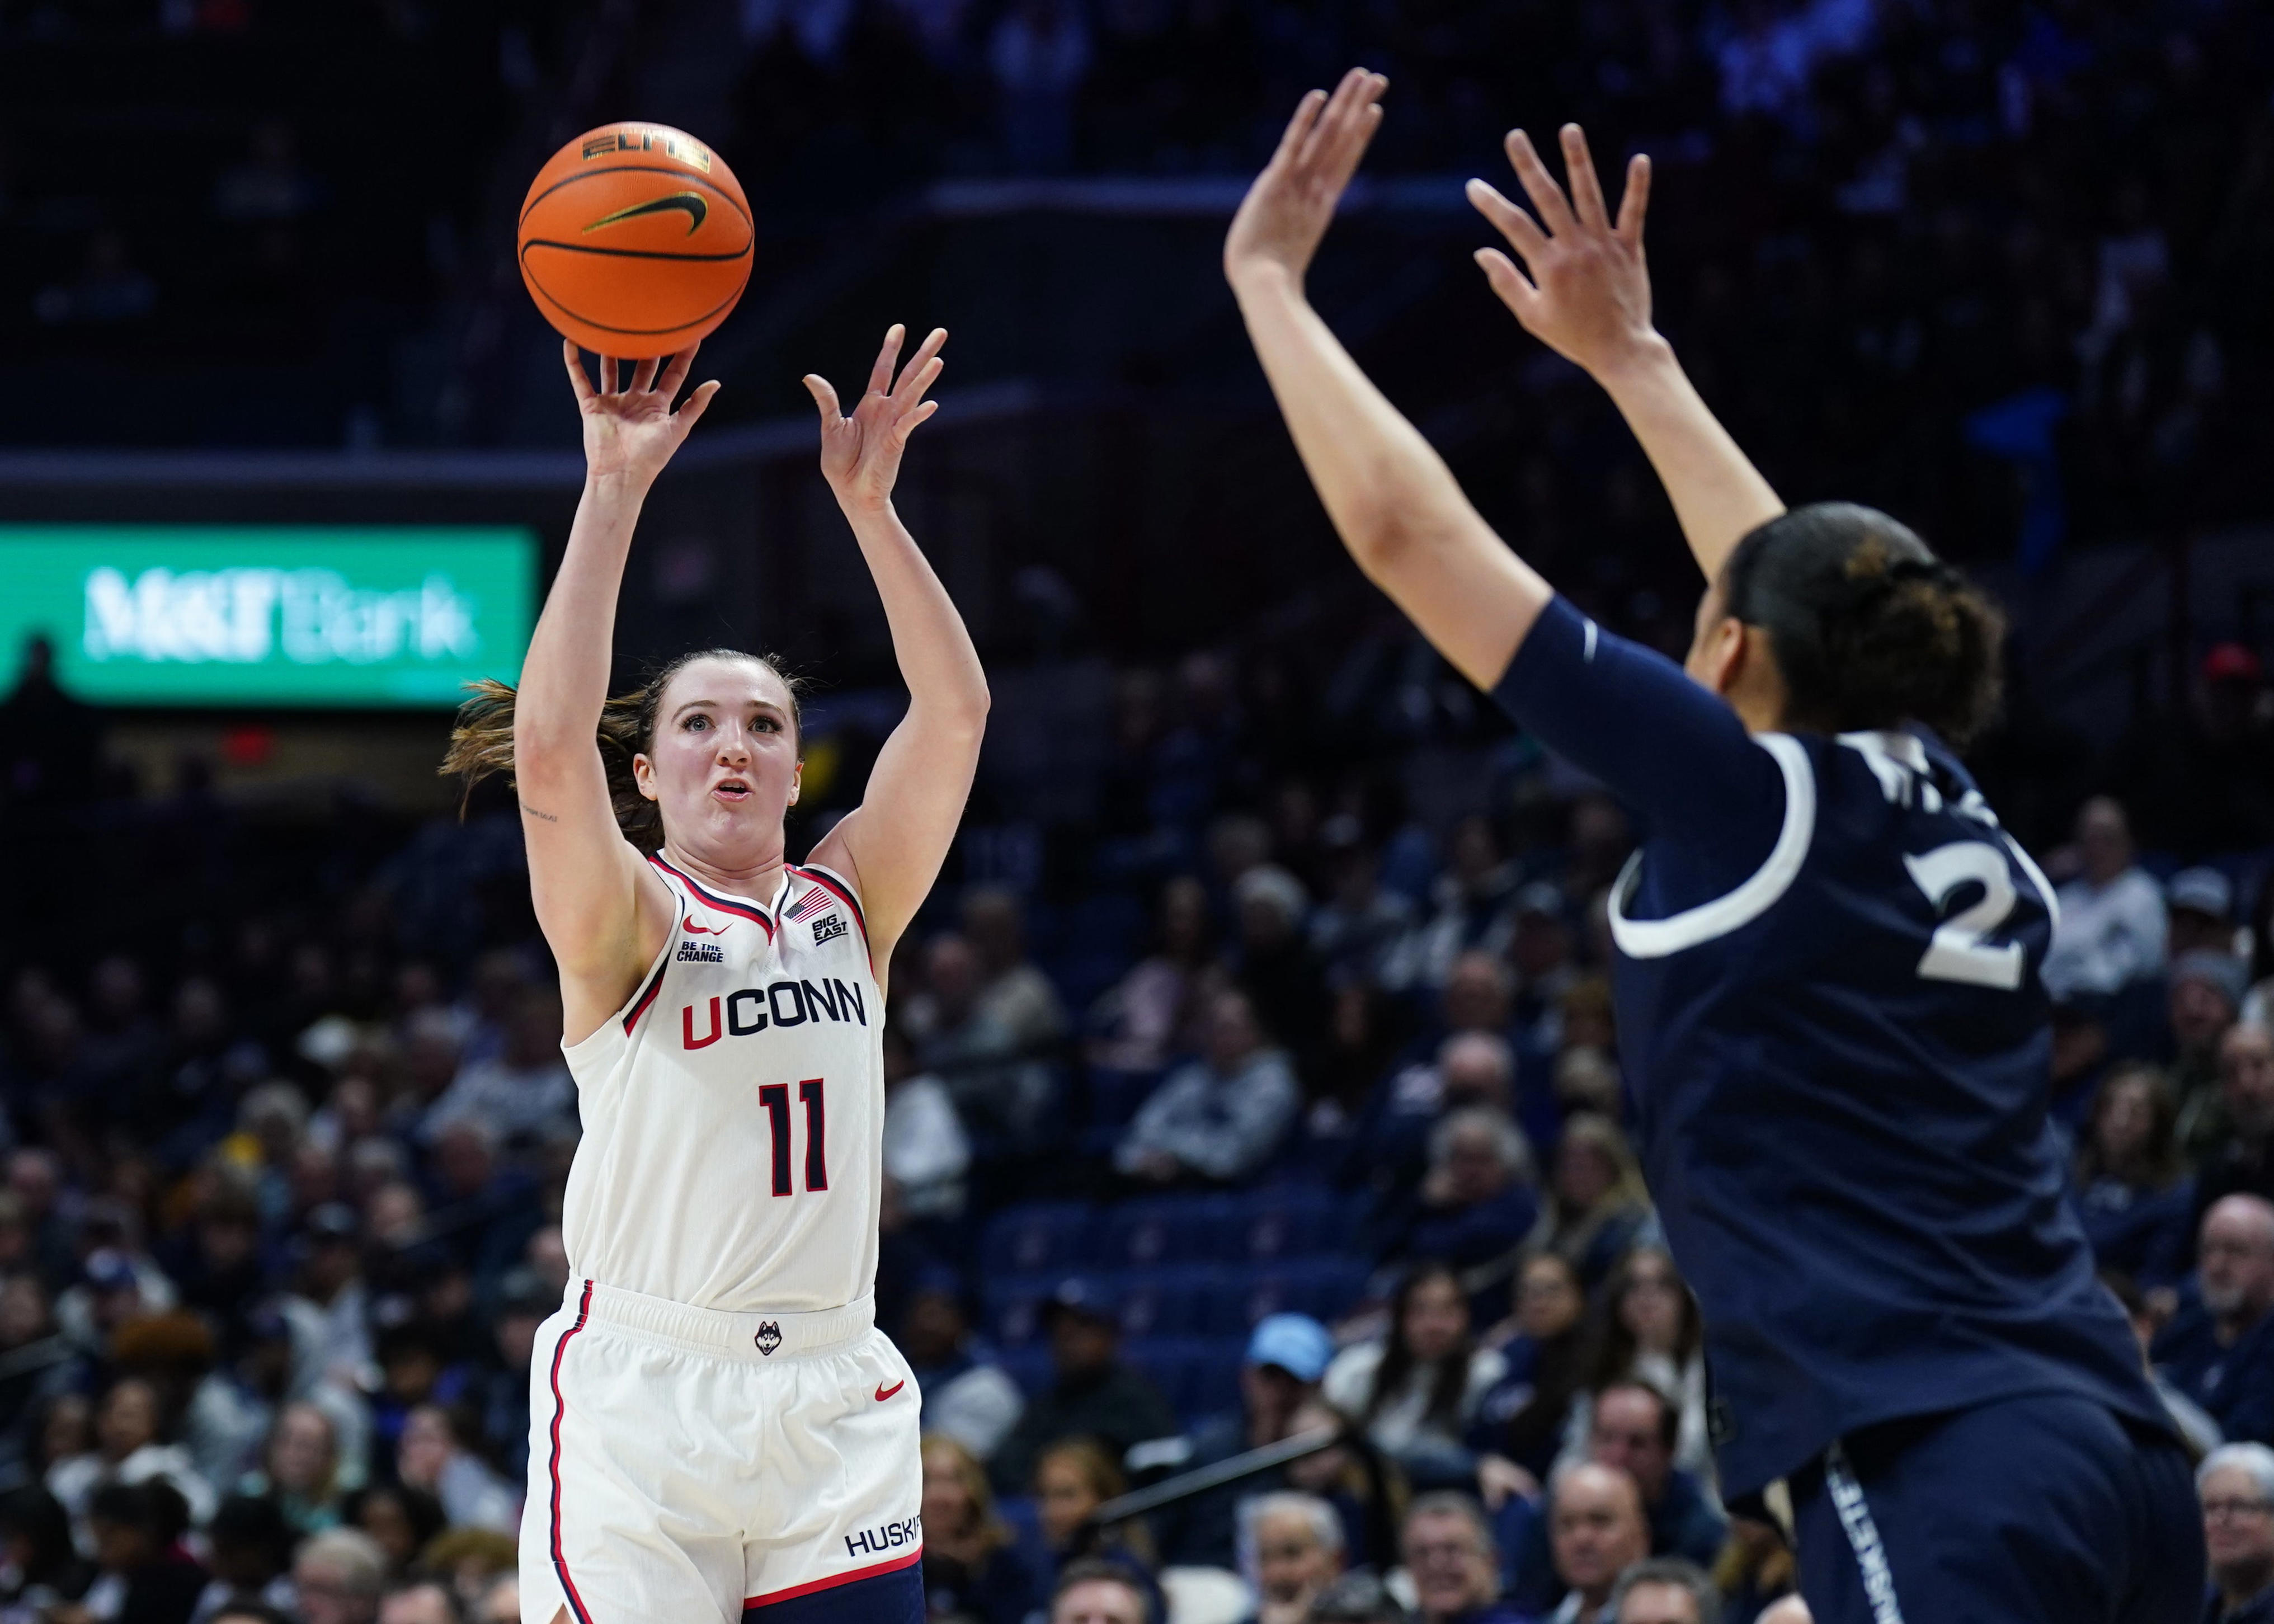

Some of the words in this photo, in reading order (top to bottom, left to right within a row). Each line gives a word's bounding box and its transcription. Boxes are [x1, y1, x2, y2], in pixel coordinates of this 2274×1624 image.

[281, 565, 480, 665] Bank
[812, 914, 837, 931] BIG
[814, 921, 847, 941] EAST
[1904, 840, 2026, 991] 2
[677, 950, 724, 962] CHANGE
[681, 941, 697, 950] BE
[700, 943, 722, 952] THE
[682, 978, 867, 1050] UCONN
[759, 1078, 827, 1197] 11
